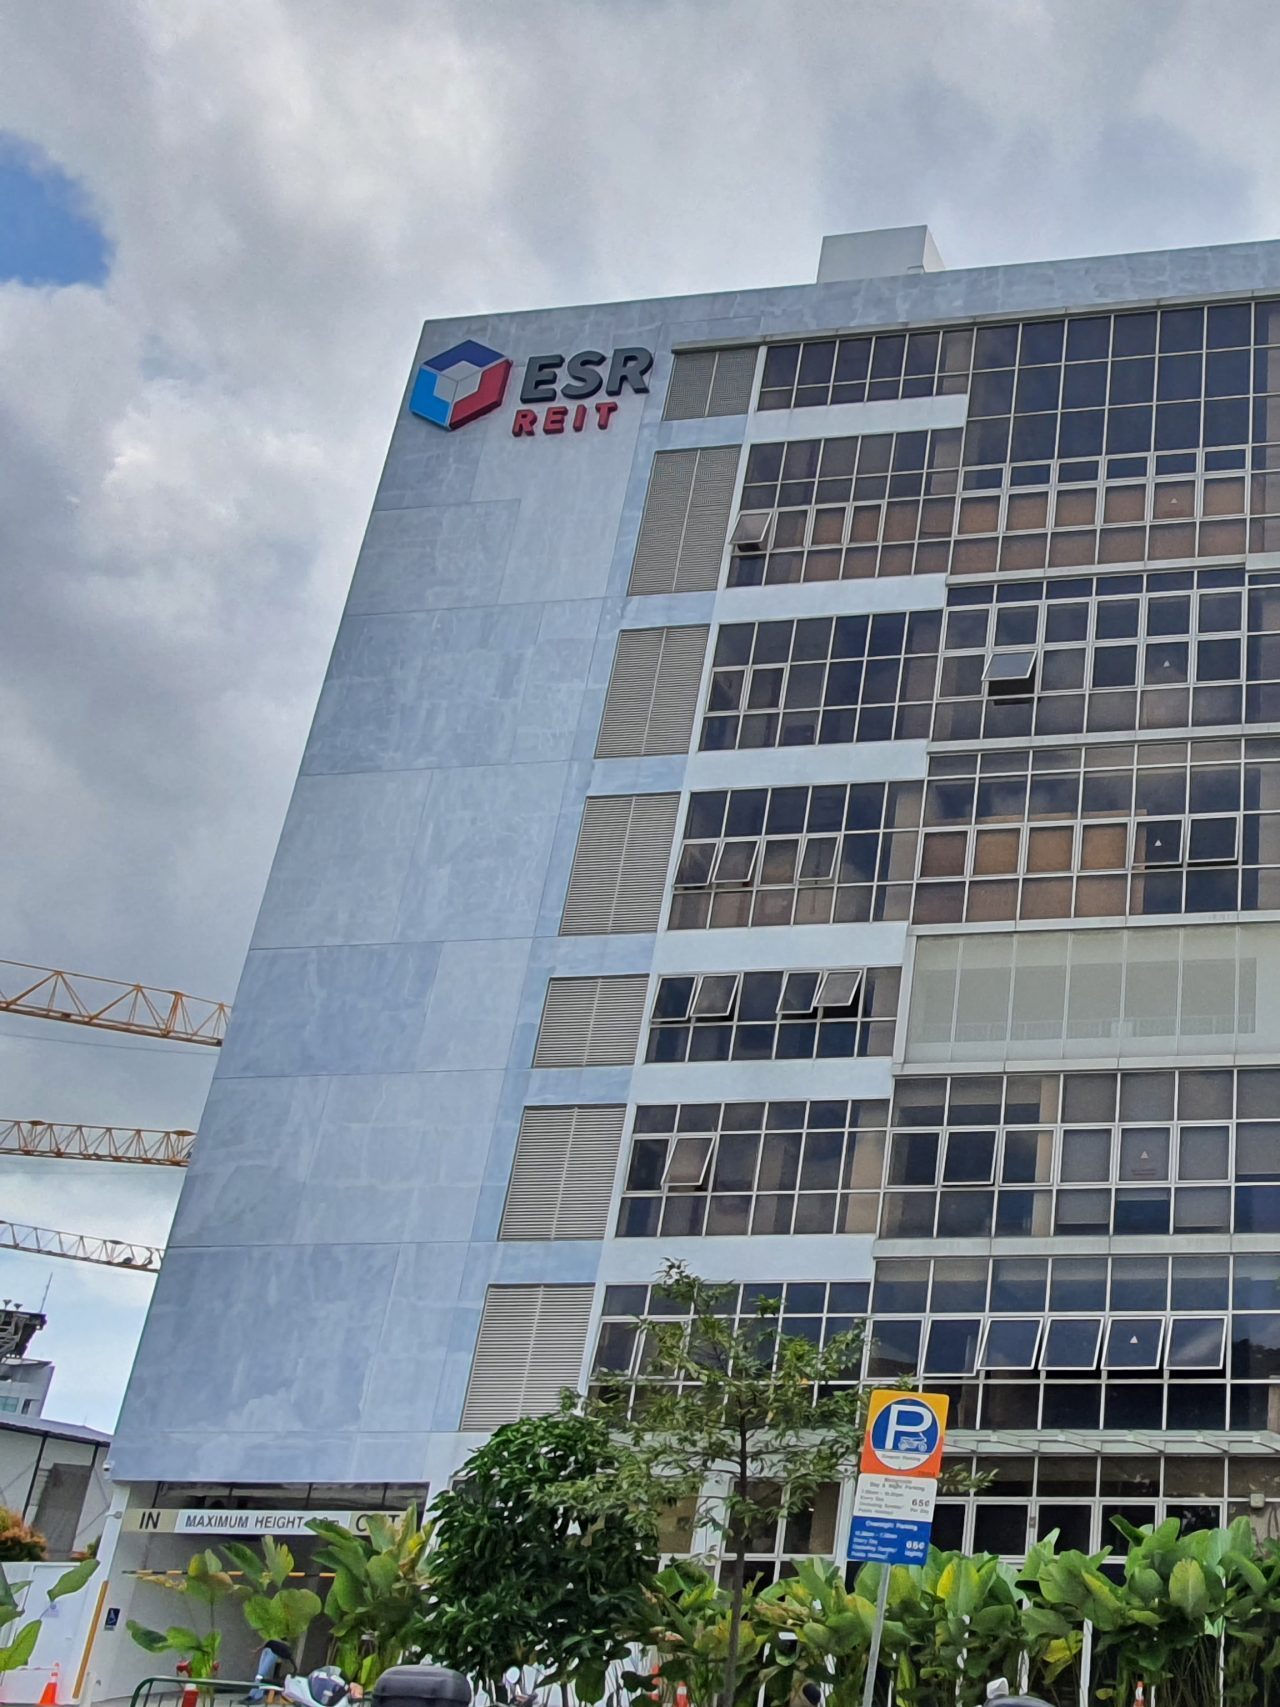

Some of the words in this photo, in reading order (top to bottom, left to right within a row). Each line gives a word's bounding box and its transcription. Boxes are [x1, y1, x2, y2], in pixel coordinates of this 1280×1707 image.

[520, 347, 654, 404] ESR
[512, 402, 618, 437] REIT
[885, 1404, 932, 1450] P
[139, 1511, 161, 1530] IN
[184, 1514, 249, 1529] MAXIMUM
[254, 1514, 305, 1530] HEIGHT
